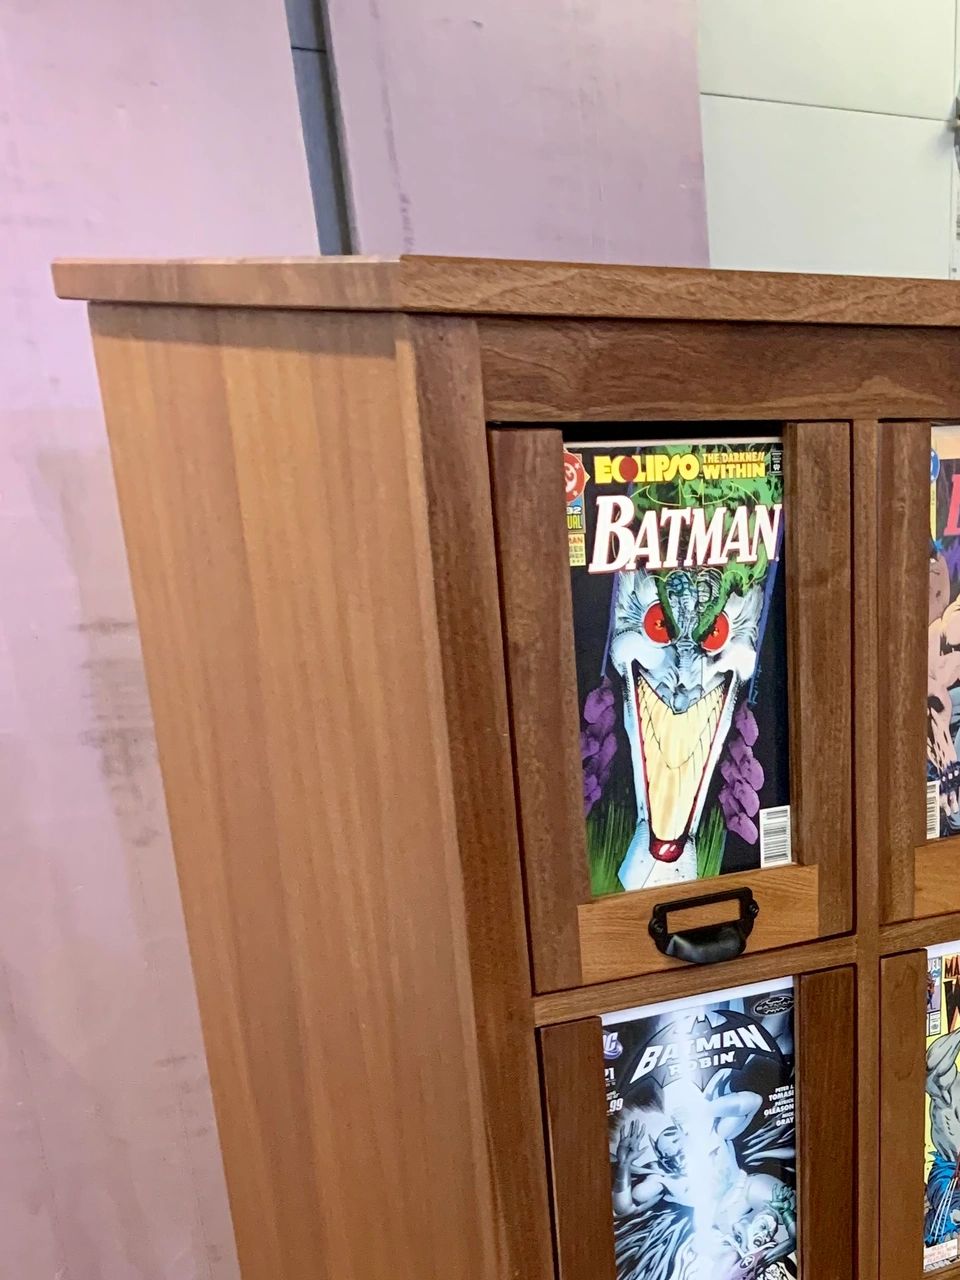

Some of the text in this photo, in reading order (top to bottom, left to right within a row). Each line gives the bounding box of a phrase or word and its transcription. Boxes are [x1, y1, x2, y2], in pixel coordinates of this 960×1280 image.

[702, 453, 720, 463] THE
[594, 453, 700, 484] ECLIPSO
[702, 463, 766, 480] WITHIN
[588, 494, 783, 574] BATMAN
[629, 1024, 772, 1084] BATMAN
[768, 1090, 794, 1101] TOMASI
[763, 1104, 794, 1116] GLEASON
[775, 1117, 794, 1127] GRAY
